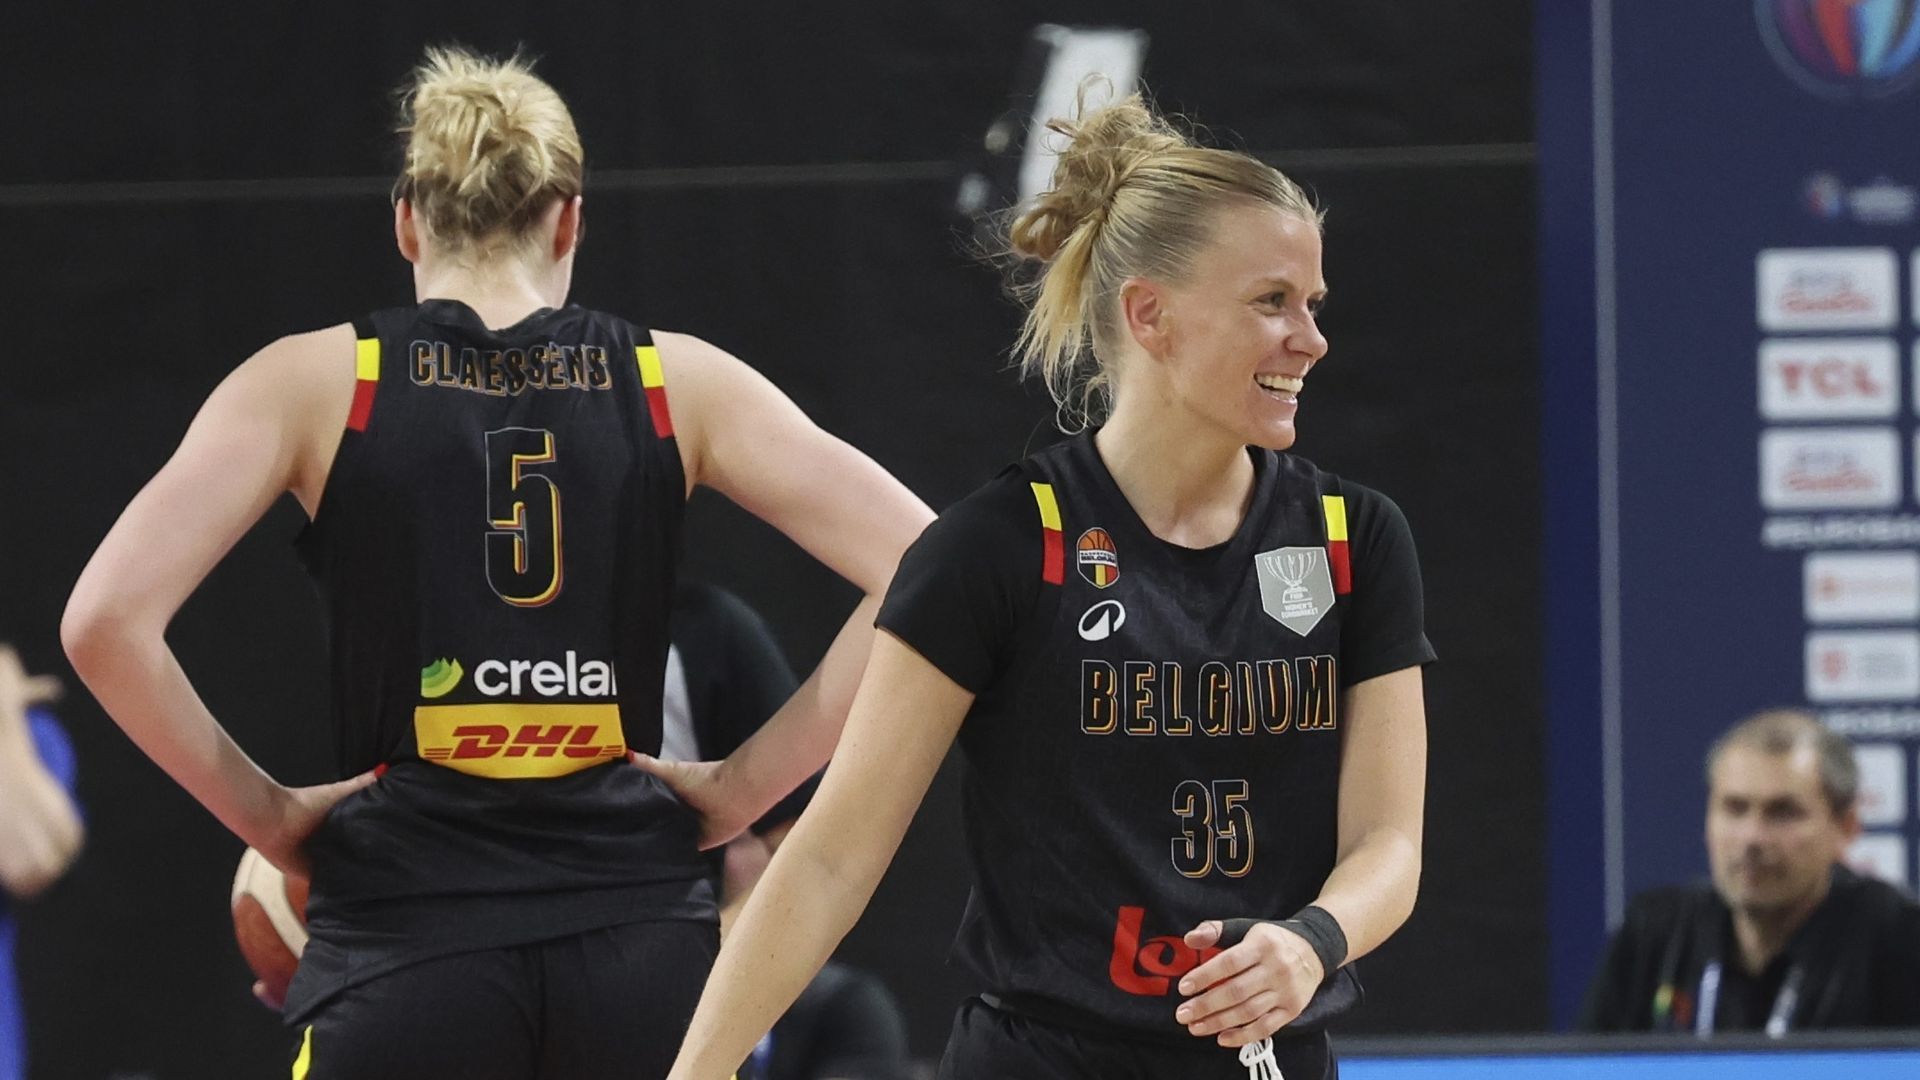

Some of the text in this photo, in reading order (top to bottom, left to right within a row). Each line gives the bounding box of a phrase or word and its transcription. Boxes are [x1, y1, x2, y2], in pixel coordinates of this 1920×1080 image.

[409, 339, 612, 397] CLAESSENS
[1778, 359, 1881, 398] TCL
[484, 426, 564, 608] 5
[473, 650, 618, 697] crela
[1081, 655, 1336, 736] BELGIUM
[451, 724, 604, 760] DHL
[1171, 779, 1254, 879] 35
